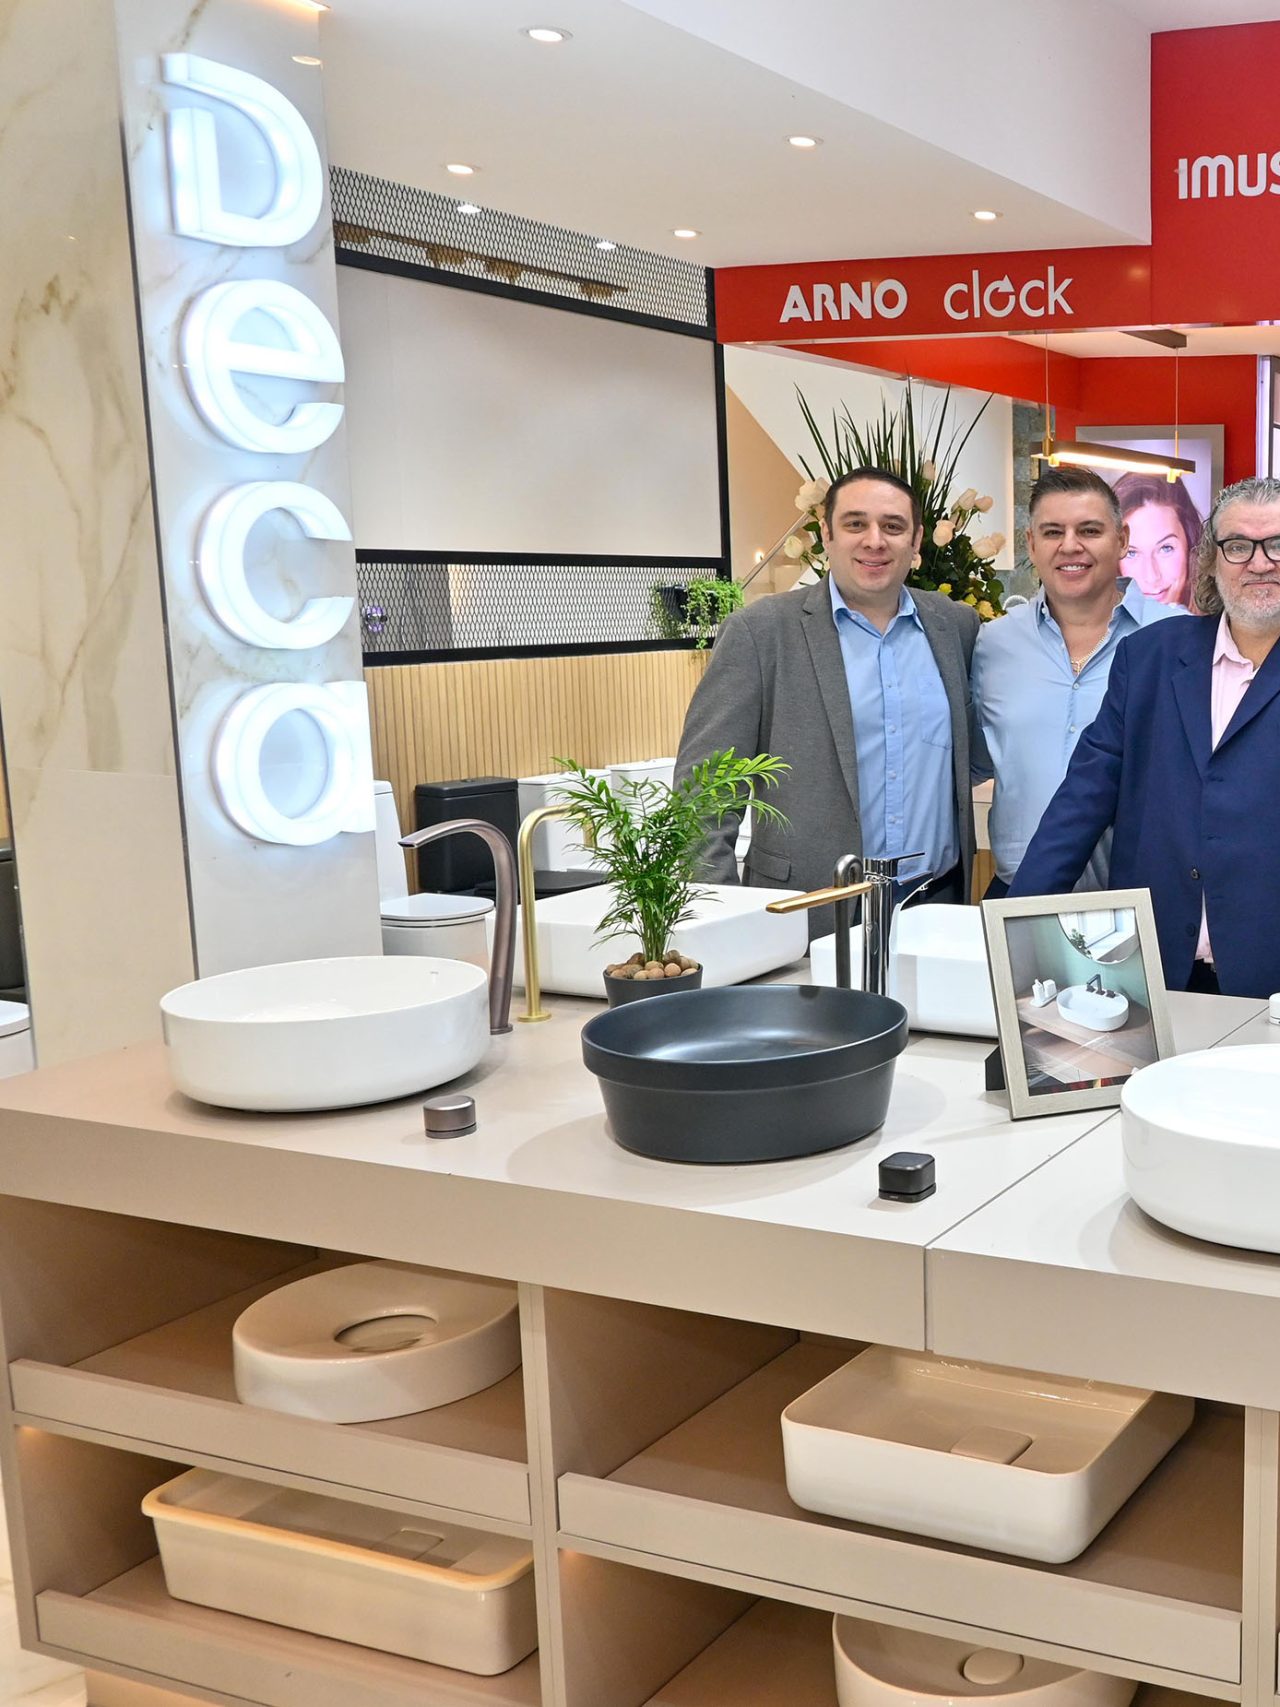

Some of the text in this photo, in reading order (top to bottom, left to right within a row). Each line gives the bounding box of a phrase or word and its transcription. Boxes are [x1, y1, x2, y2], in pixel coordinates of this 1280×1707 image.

[779, 278, 908, 324] ARNO
[943, 265, 1074, 320] clock
[160, 51, 377, 847] Deca
